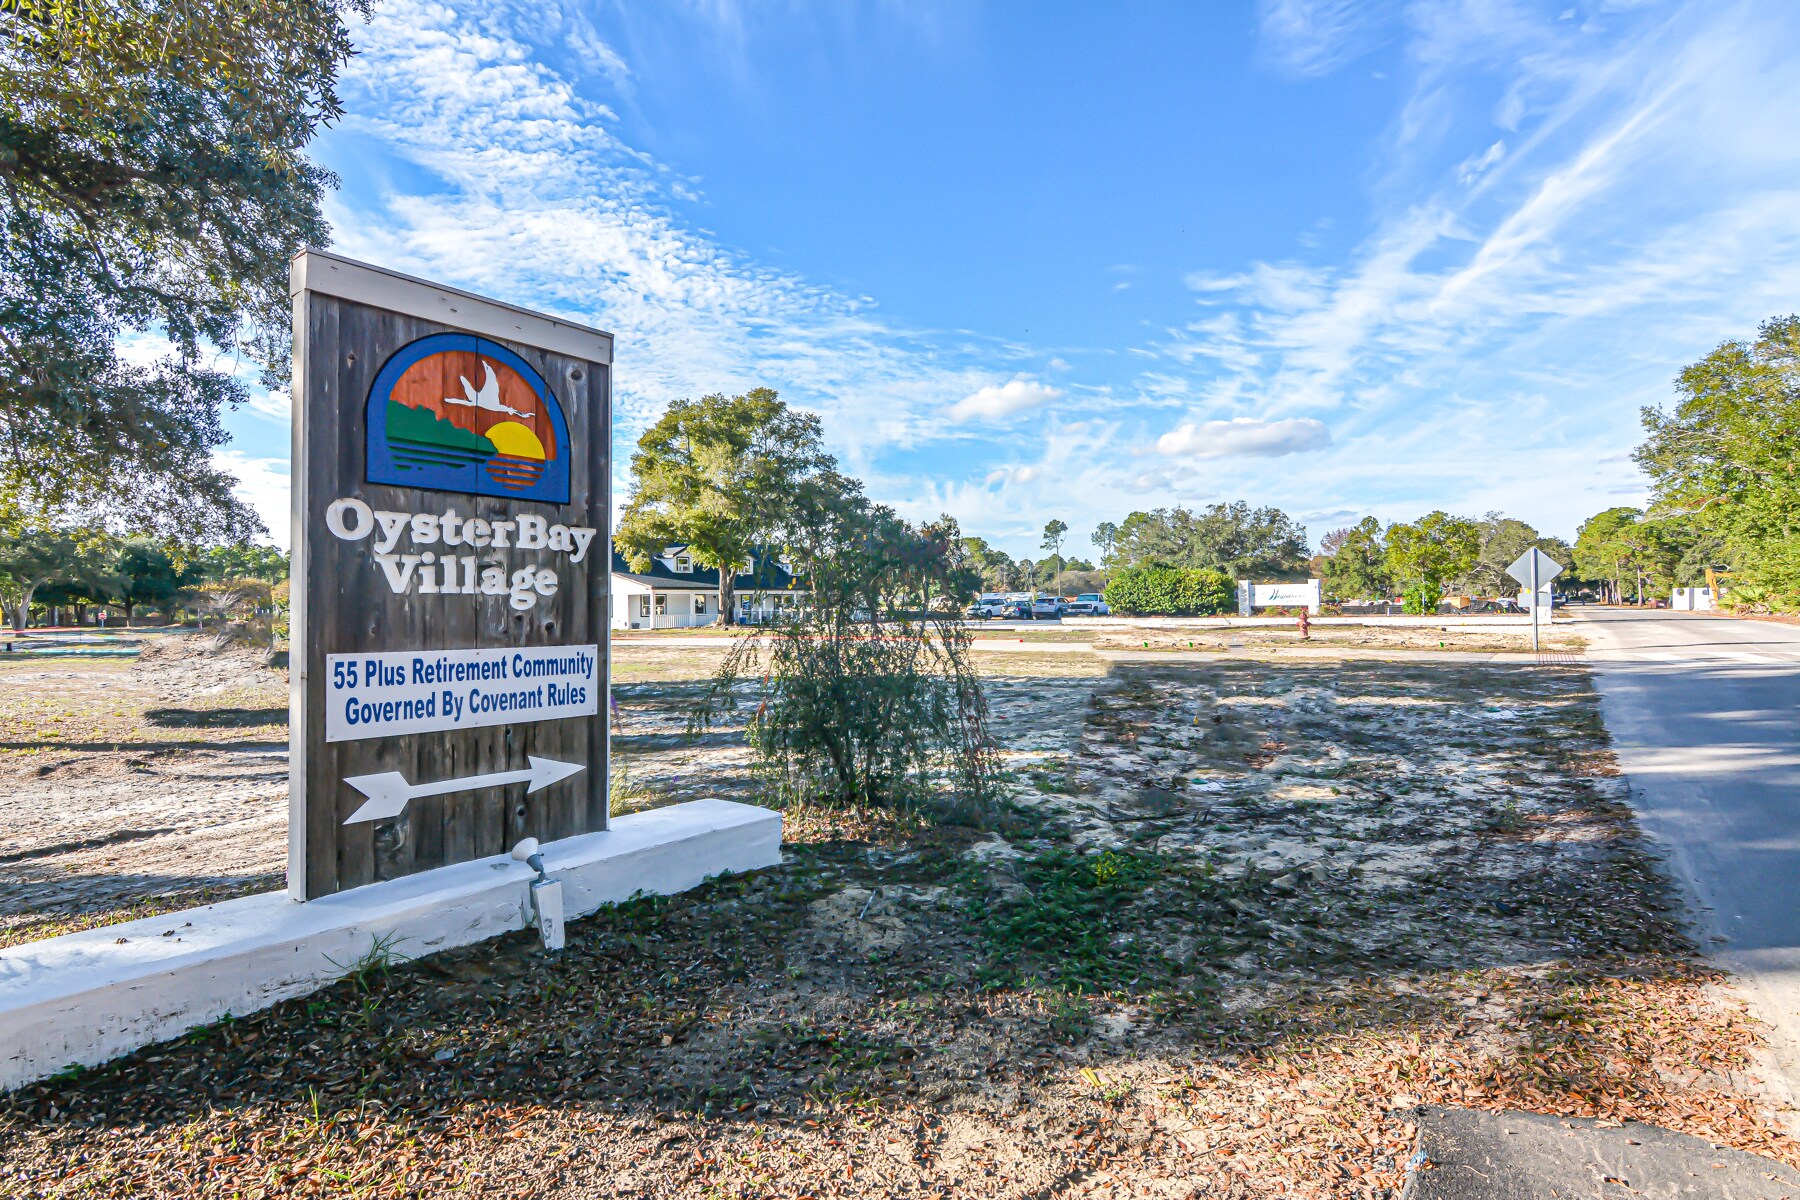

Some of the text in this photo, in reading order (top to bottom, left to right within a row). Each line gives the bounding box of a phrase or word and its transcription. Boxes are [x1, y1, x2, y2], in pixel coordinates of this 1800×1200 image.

[375, 551, 558, 610] Village
[334, 652, 593, 689] 55 Plus Retirement Community
[345, 682, 586, 725] Governed By Covenant Rules
